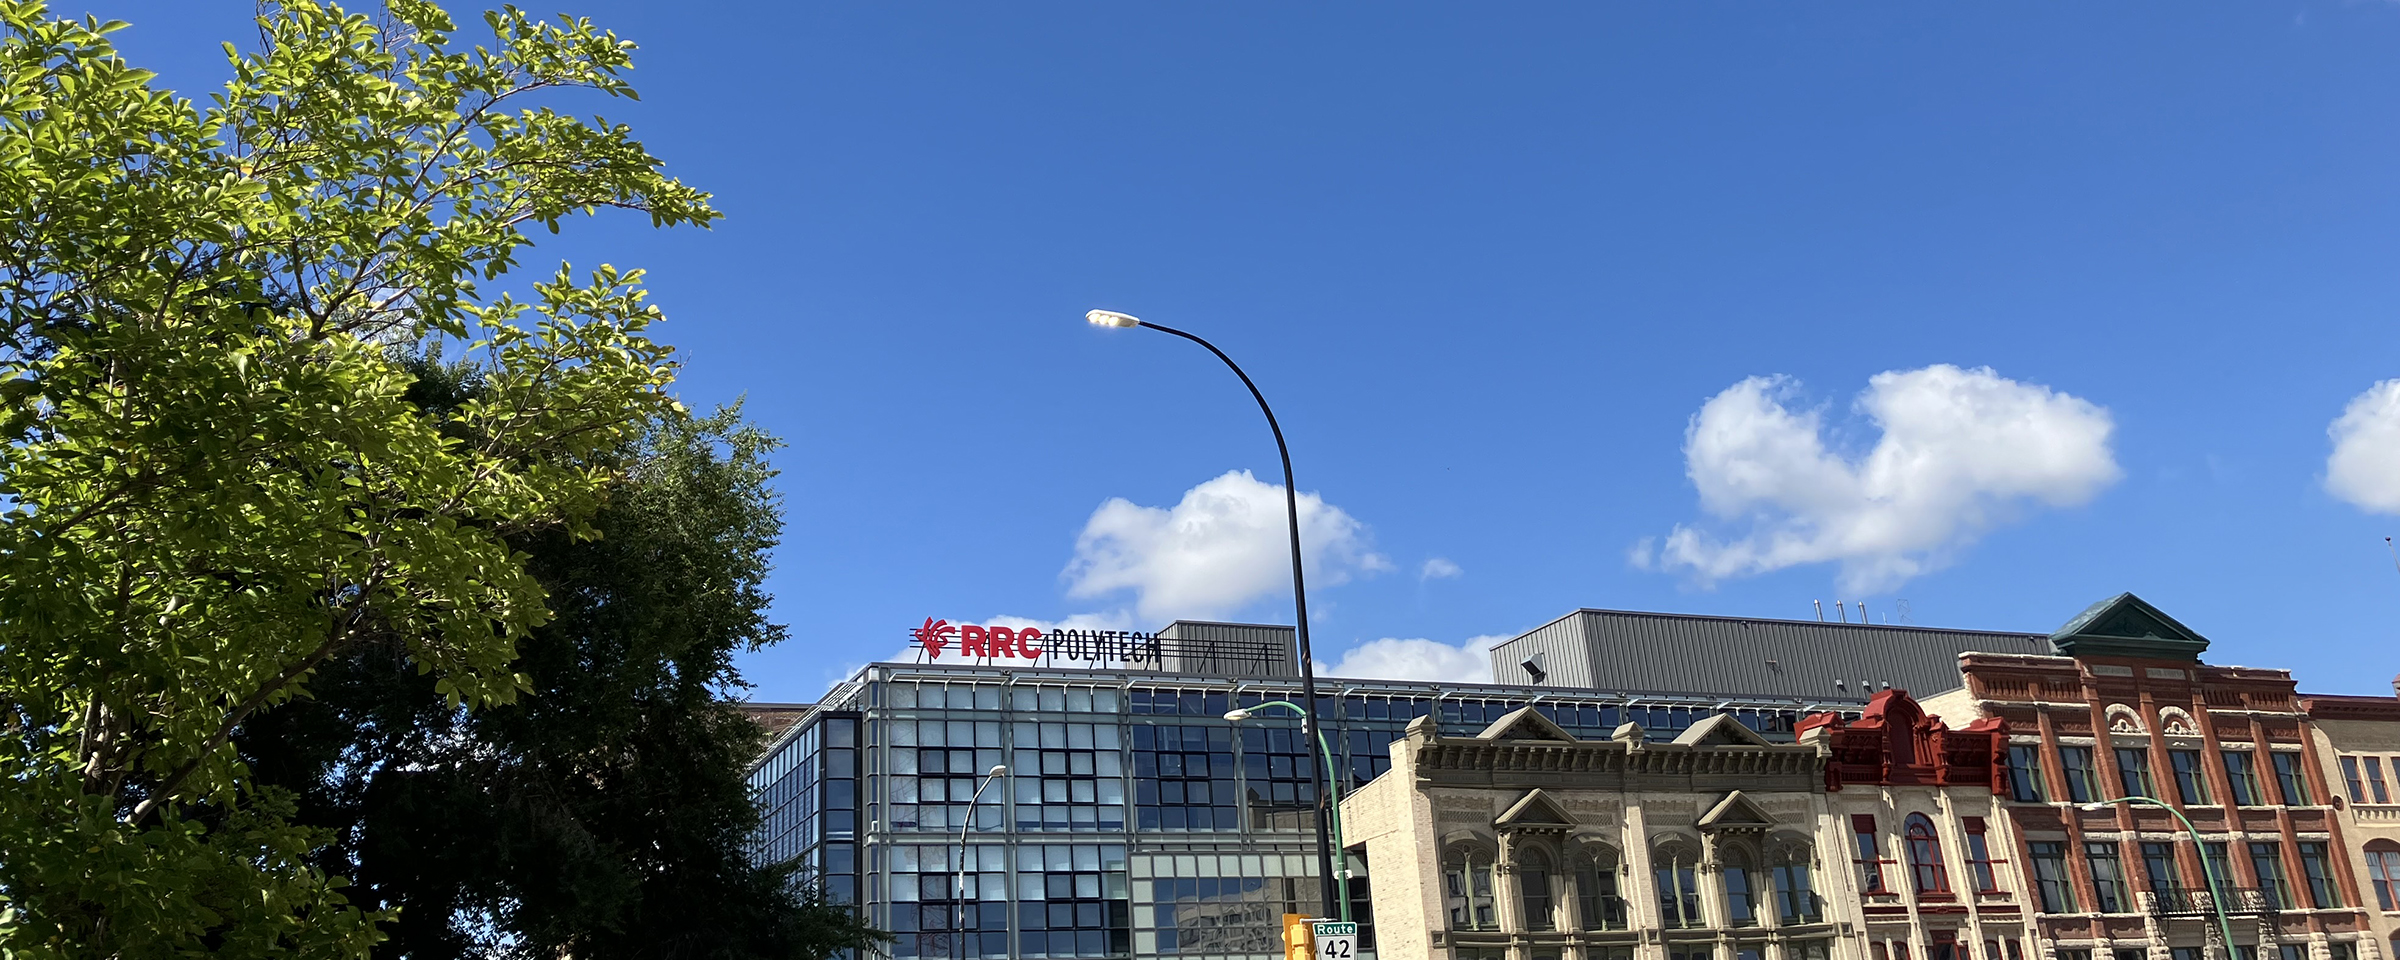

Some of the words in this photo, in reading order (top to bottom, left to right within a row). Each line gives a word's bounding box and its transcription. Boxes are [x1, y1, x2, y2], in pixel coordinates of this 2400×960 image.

[961, 625, 1042, 659] RRC
[1053, 628, 1160, 663] POLYTECH
[1317, 925, 1353, 934] Route
[1325, 940, 1350, 958] 42
